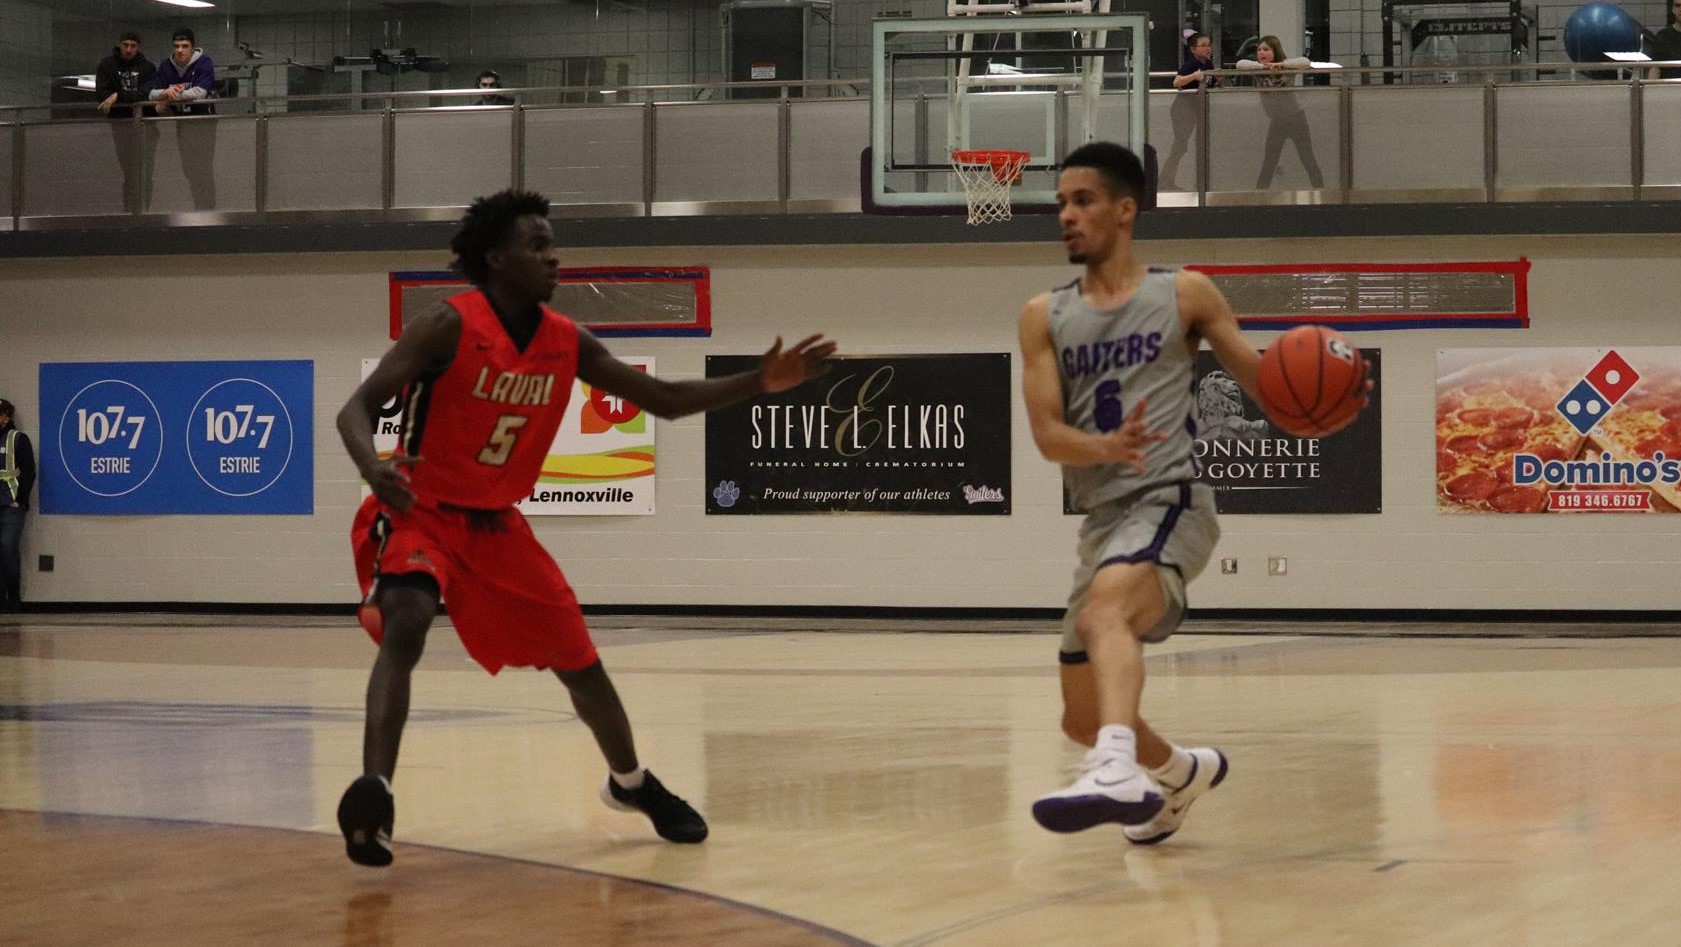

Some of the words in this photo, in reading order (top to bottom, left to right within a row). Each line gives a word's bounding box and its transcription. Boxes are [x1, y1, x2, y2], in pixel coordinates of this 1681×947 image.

[1094, 380, 1123, 433] 6
[77, 405, 146, 450] 107.7
[205, 404, 275, 449] 107.7
[751, 405, 830, 449] STEVE
[887, 404, 965, 449] ELKAS
[476, 414, 529, 467] 5
[1192, 438, 1321, 458] ONNERIE
[91, 457, 131, 474] ESTRIE
[220, 456, 260, 473] ESTRIE
[1207, 462, 1321, 479] GOYETTE
[1515, 452, 1680, 484] Domino's
[529, 488, 634, 502] Lennoxville
[763, 487, 801, 500] Proud
[803, 488, 861, 502] supporter
[864, 488, 878, 502] of
[879, 490, 900, 500] our
[904, 488, 951, 500] athletes
[1558, 495, 1581, 507] 819
[1585, 495, 1643, 507] 346.6767
